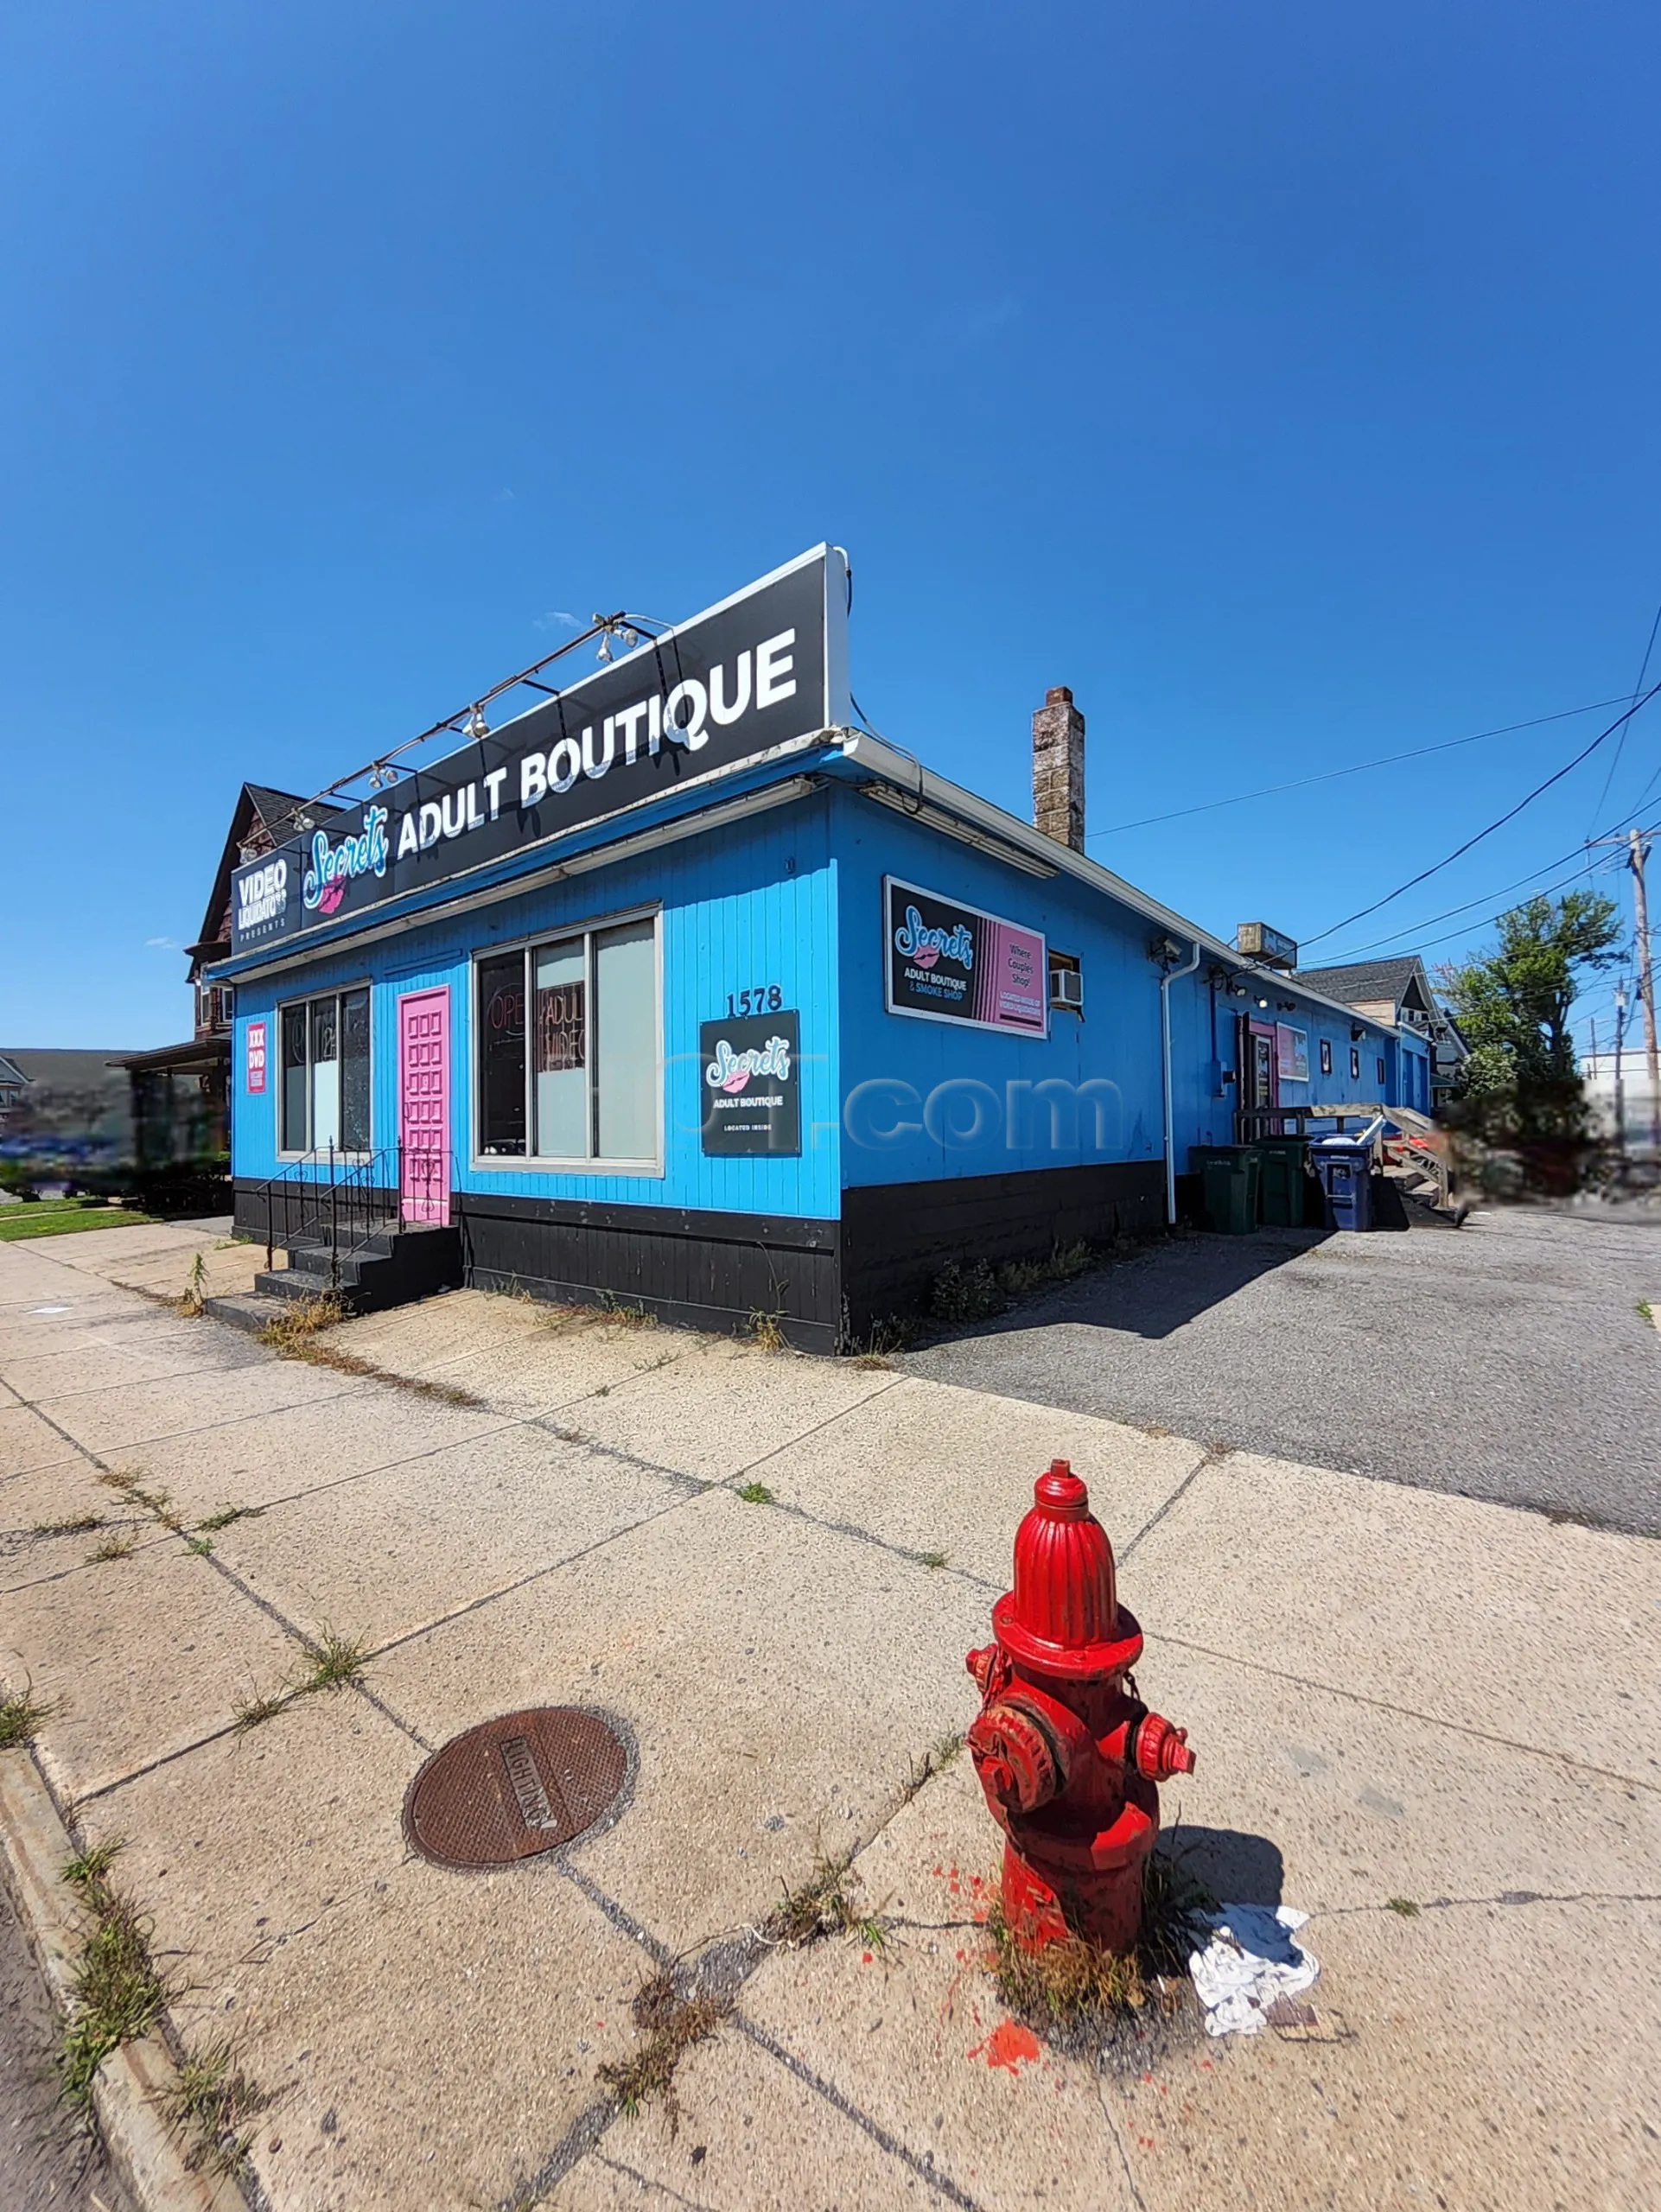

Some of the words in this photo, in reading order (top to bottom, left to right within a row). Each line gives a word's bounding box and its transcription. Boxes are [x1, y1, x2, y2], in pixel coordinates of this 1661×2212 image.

[303, 805, 389, 910] Secrets
[397, 767, 506, 859] ADULT
[521, 628, 796, 809] BOUTIQUE
[239, 859, 287, 906] VIDEO
[239, 918, 285, 942] PRESENTS
[894, 905, 973, 970] Secrets
[1009, 944, 1032, 960] Where
[1008, 957, 1034, 974] Couples
[904, 967, 931, 983] ADULT
[931, 972, 967, 991] BOUTIQUE
[727, 985, 782, 1018] 1578
[916, 983, 943, 998] SMOKE
[944, 988, 963, 1001] SHOP
[492, 993, 525, 1028] OPE
[546, 993, 584, 1025] ADUL
[248, 1028, 264, 1048] XXX
[248, 1050, 264, 1069] DVD
[706, 1035, 790, 1087] Secrets
[714, 1098, 739, 1109] ADULT
[740, 1096, 784, 1108] BOUTIQUE
